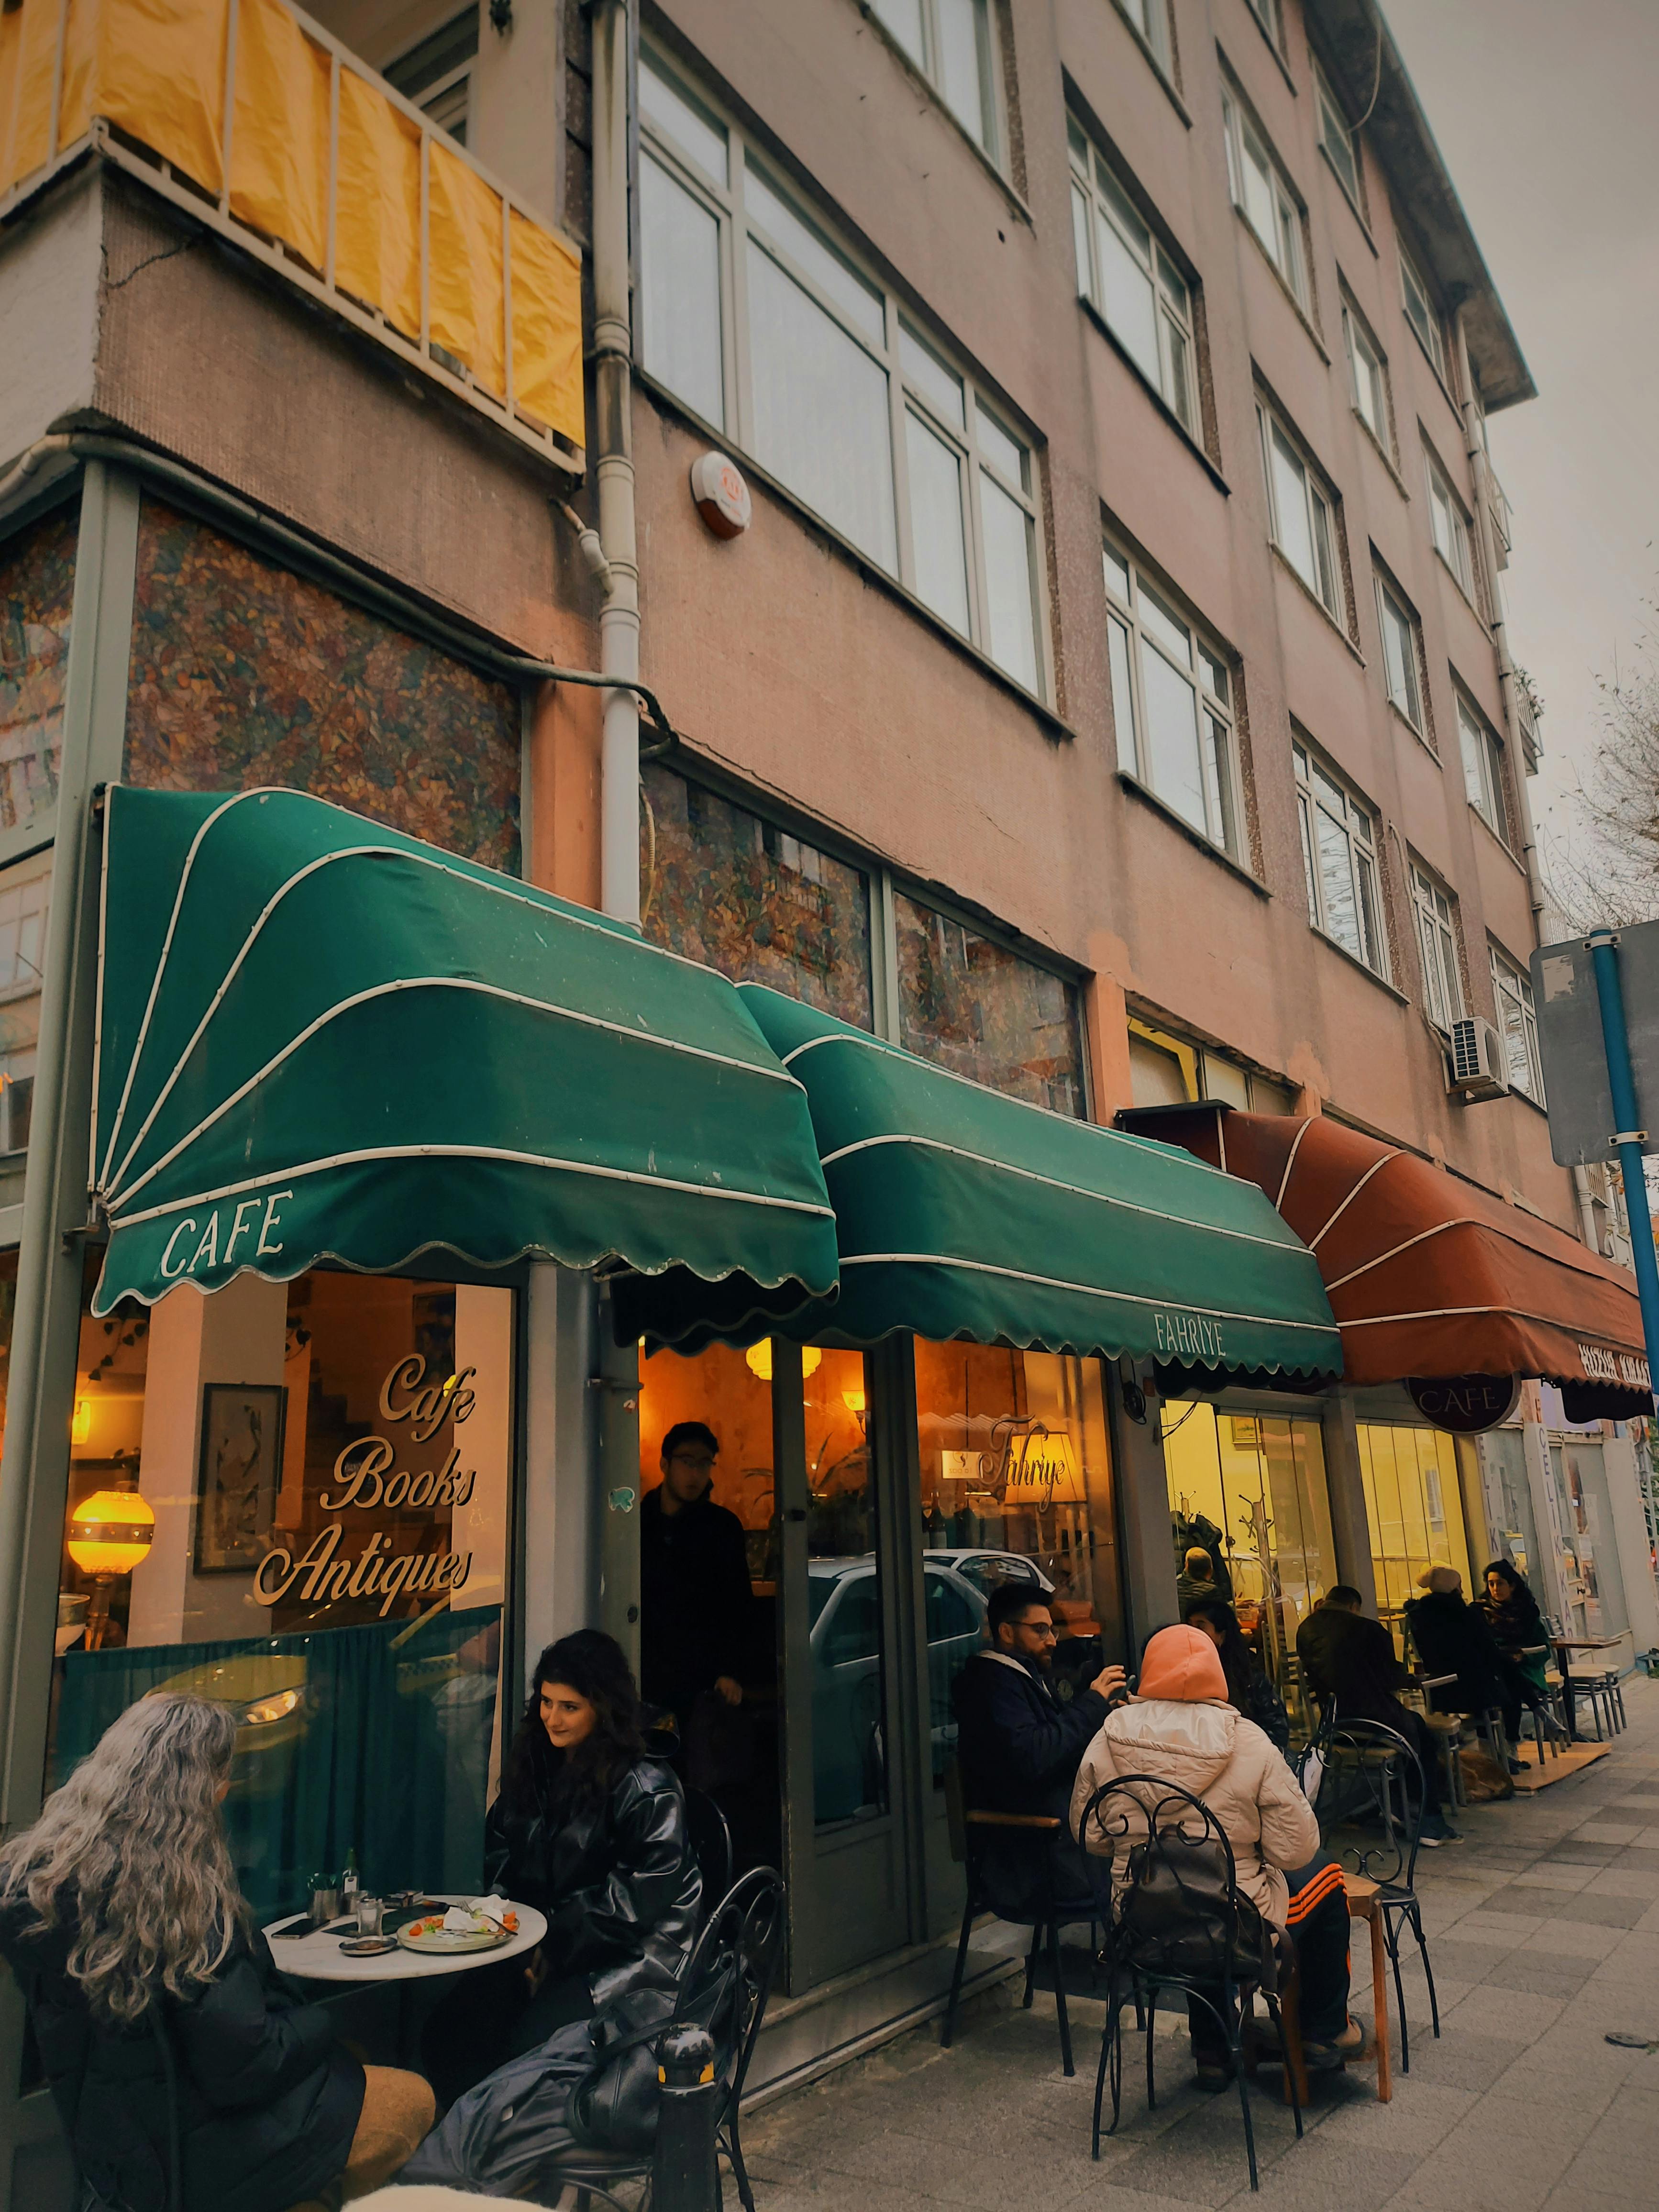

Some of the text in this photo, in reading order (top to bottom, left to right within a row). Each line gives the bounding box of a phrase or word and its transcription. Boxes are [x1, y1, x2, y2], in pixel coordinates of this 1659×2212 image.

[160, 1189, 293, 1277] CAFE
[379, 1353, 476, 1443] Cafe
[1418, 1387, 1500, 1416] CAFE
[1578, 1343, 1621, 1381] HUZUR
[320, 1436, 476, 1510] Books
[253, 1523, 473, 1617] Antiques
